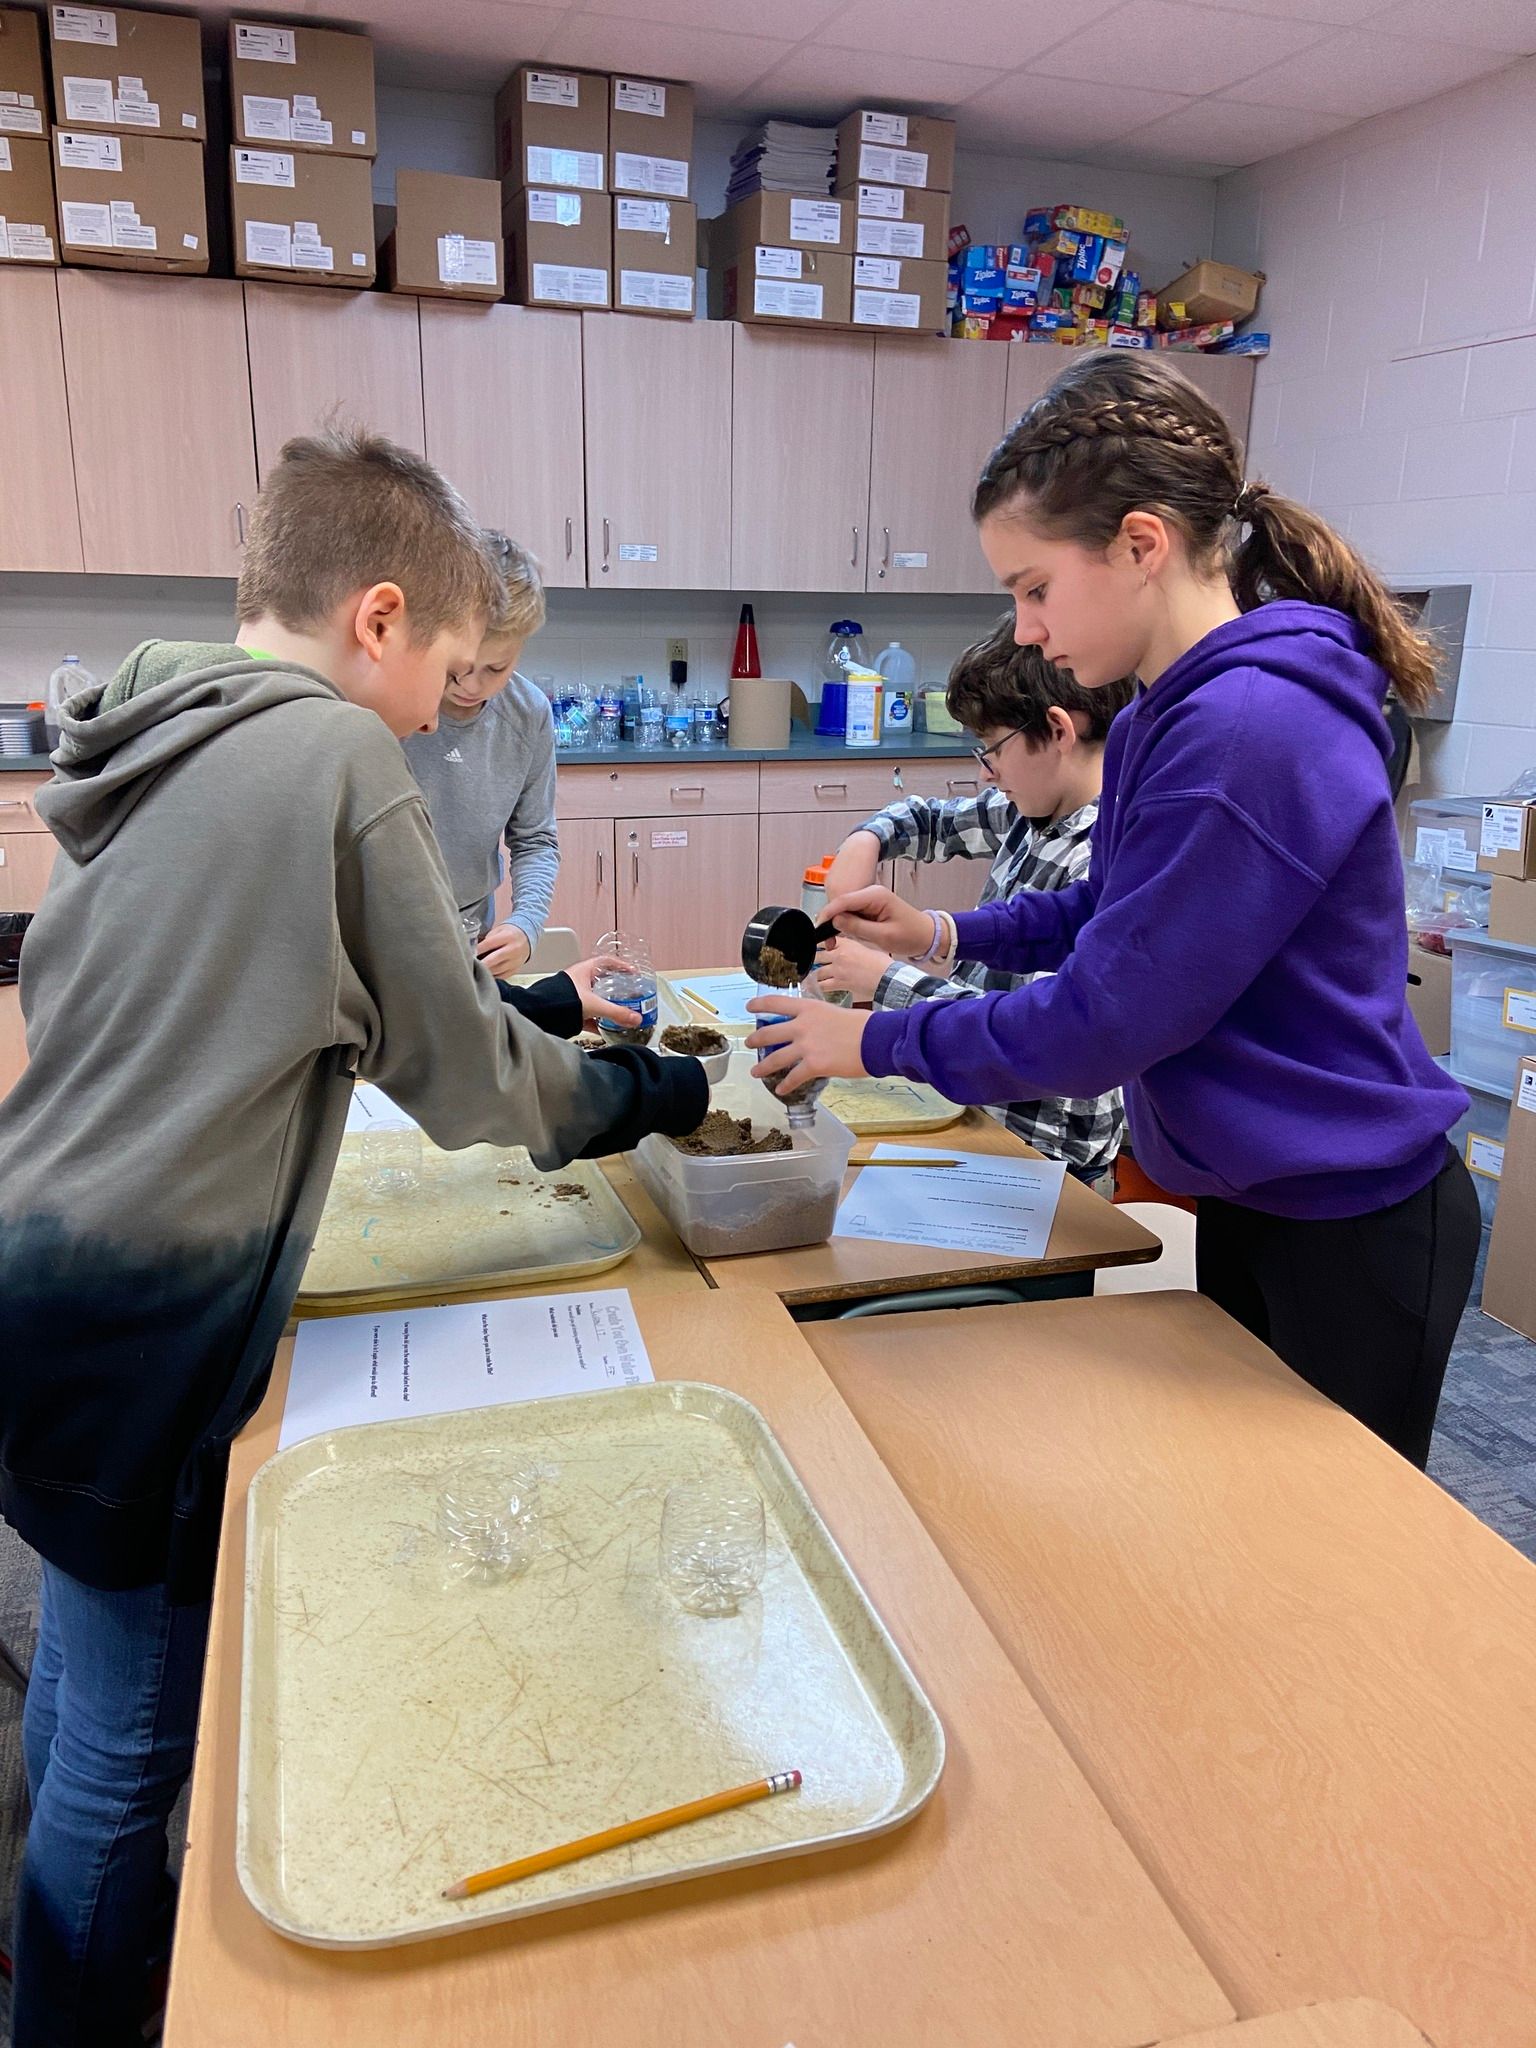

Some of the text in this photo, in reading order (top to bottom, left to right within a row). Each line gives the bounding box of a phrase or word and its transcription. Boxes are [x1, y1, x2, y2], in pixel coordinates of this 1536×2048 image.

[1077, 245, 1086, 268] Ziploc
[974, 270, 997, 281] Ziploc
[1011, 290, 1030, 300] Ziploc
[973, 297, 990, 305] Ziploc
[611, 1325, 625, 1339] You
